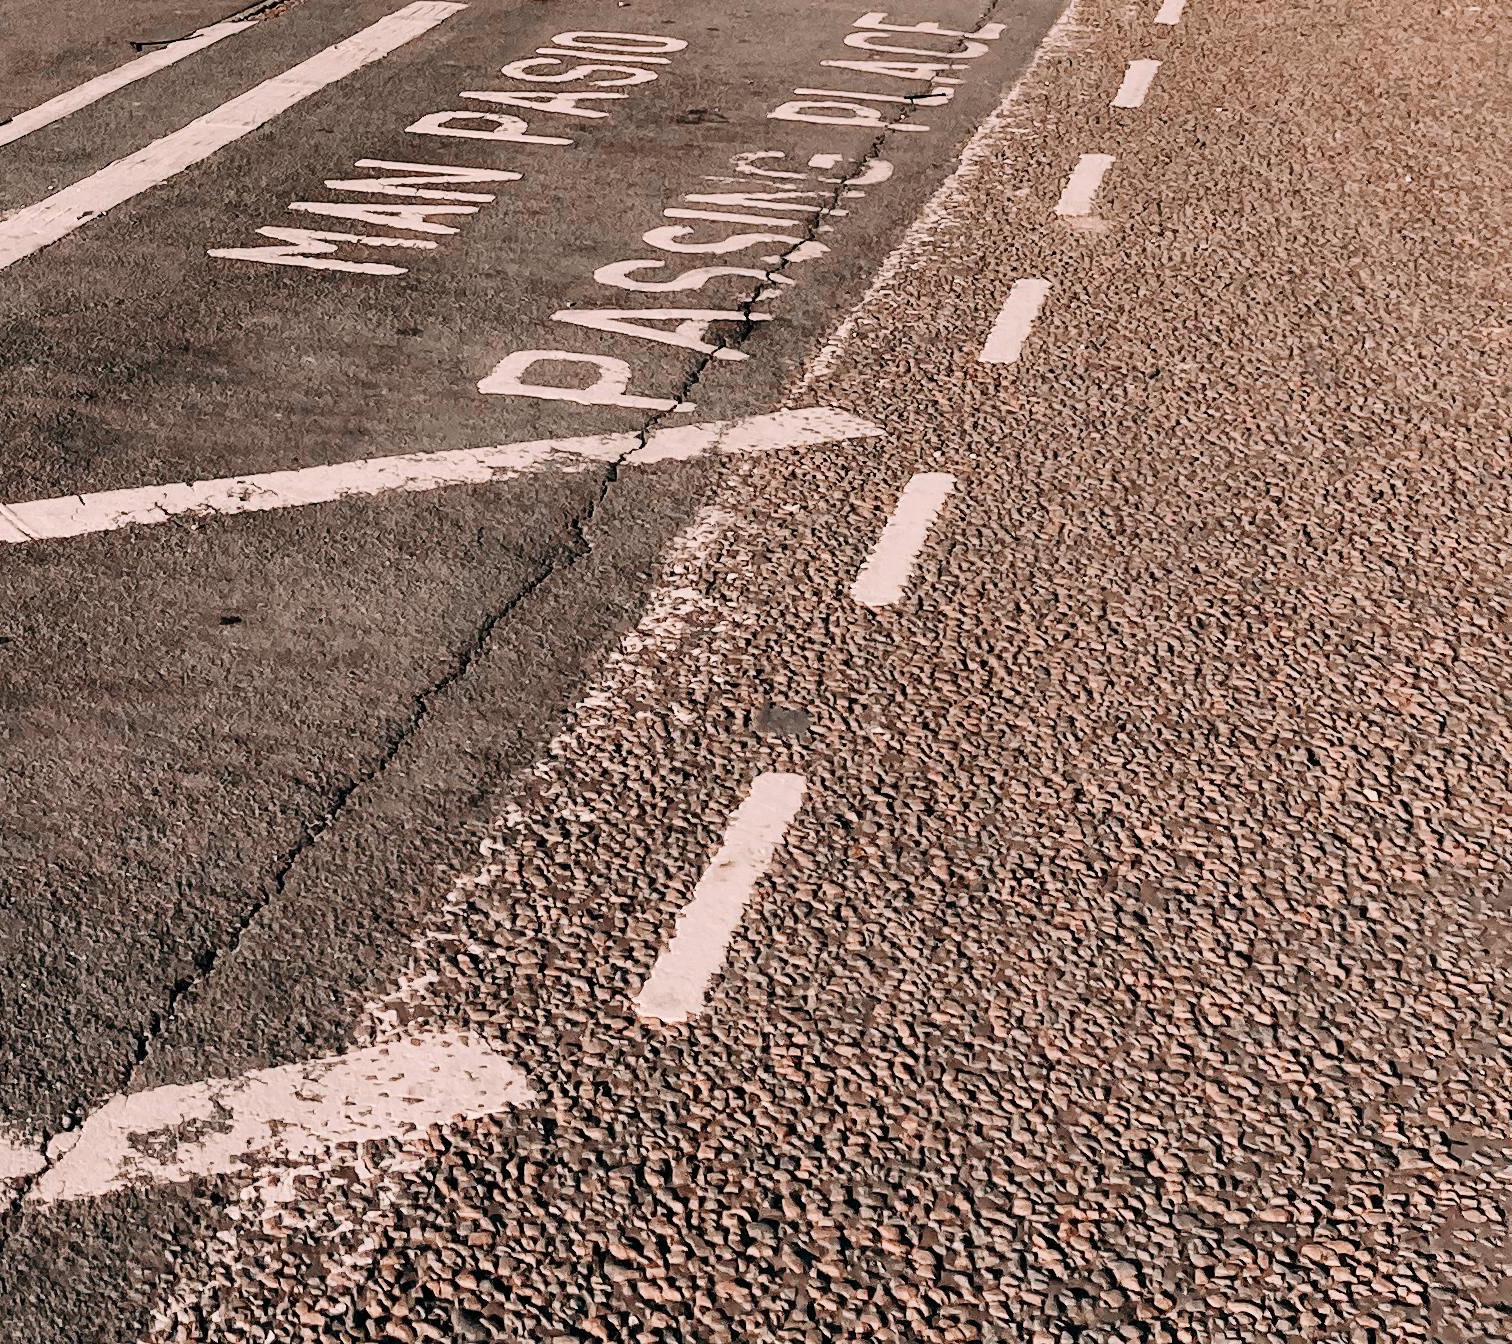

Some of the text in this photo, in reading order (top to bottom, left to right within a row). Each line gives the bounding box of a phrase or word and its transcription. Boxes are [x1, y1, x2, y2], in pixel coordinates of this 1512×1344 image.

[205, 30, 689, 276] MAN PASIO
[766, 11, 1007, 134] PLACE
